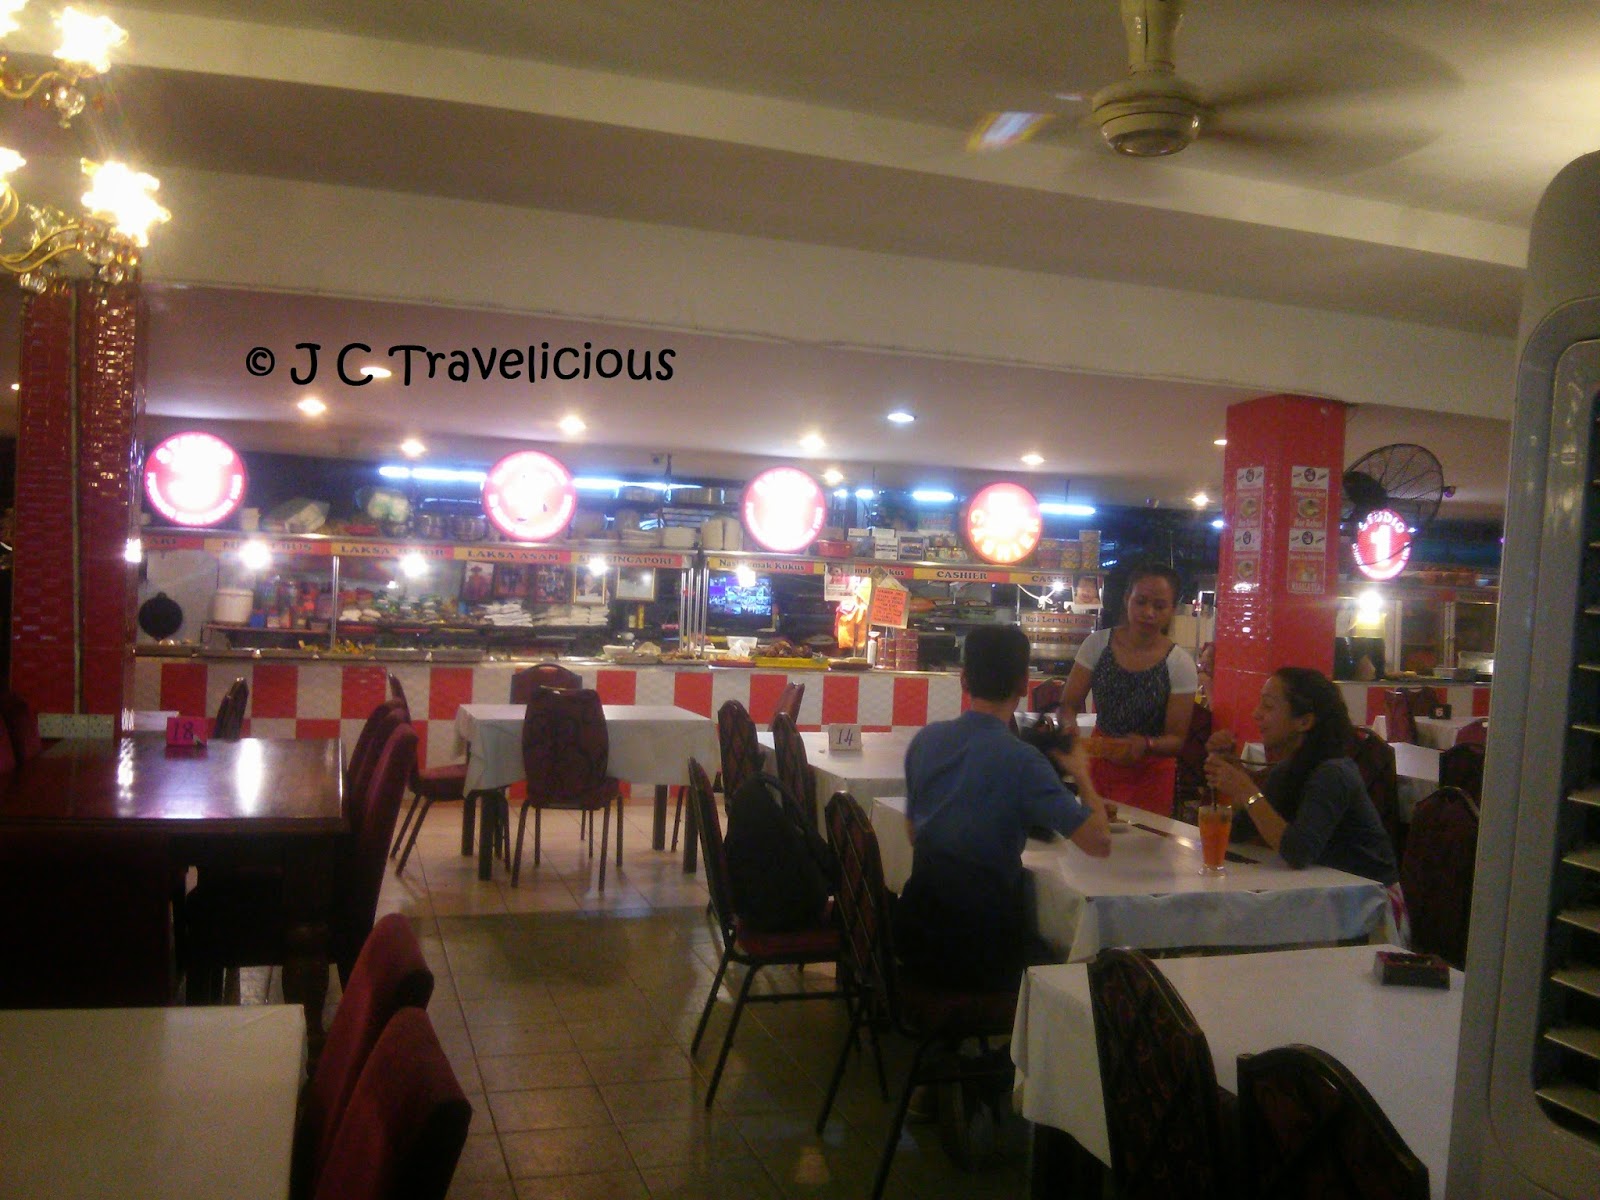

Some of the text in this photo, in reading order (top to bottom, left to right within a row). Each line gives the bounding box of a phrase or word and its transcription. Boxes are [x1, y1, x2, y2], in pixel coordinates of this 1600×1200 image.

[1359, 511, 1405, 533] STUDIO
[341, 546, 390, 554] LAKSA
[1370, 524, 1391, 566] 1
[467, 550, 558, 560] LAKSA ASAM
[774, 562, 804, 571] Kukus
[936, 571, 987, 580] CASHIER
[836, 729, 853, 746] 14
